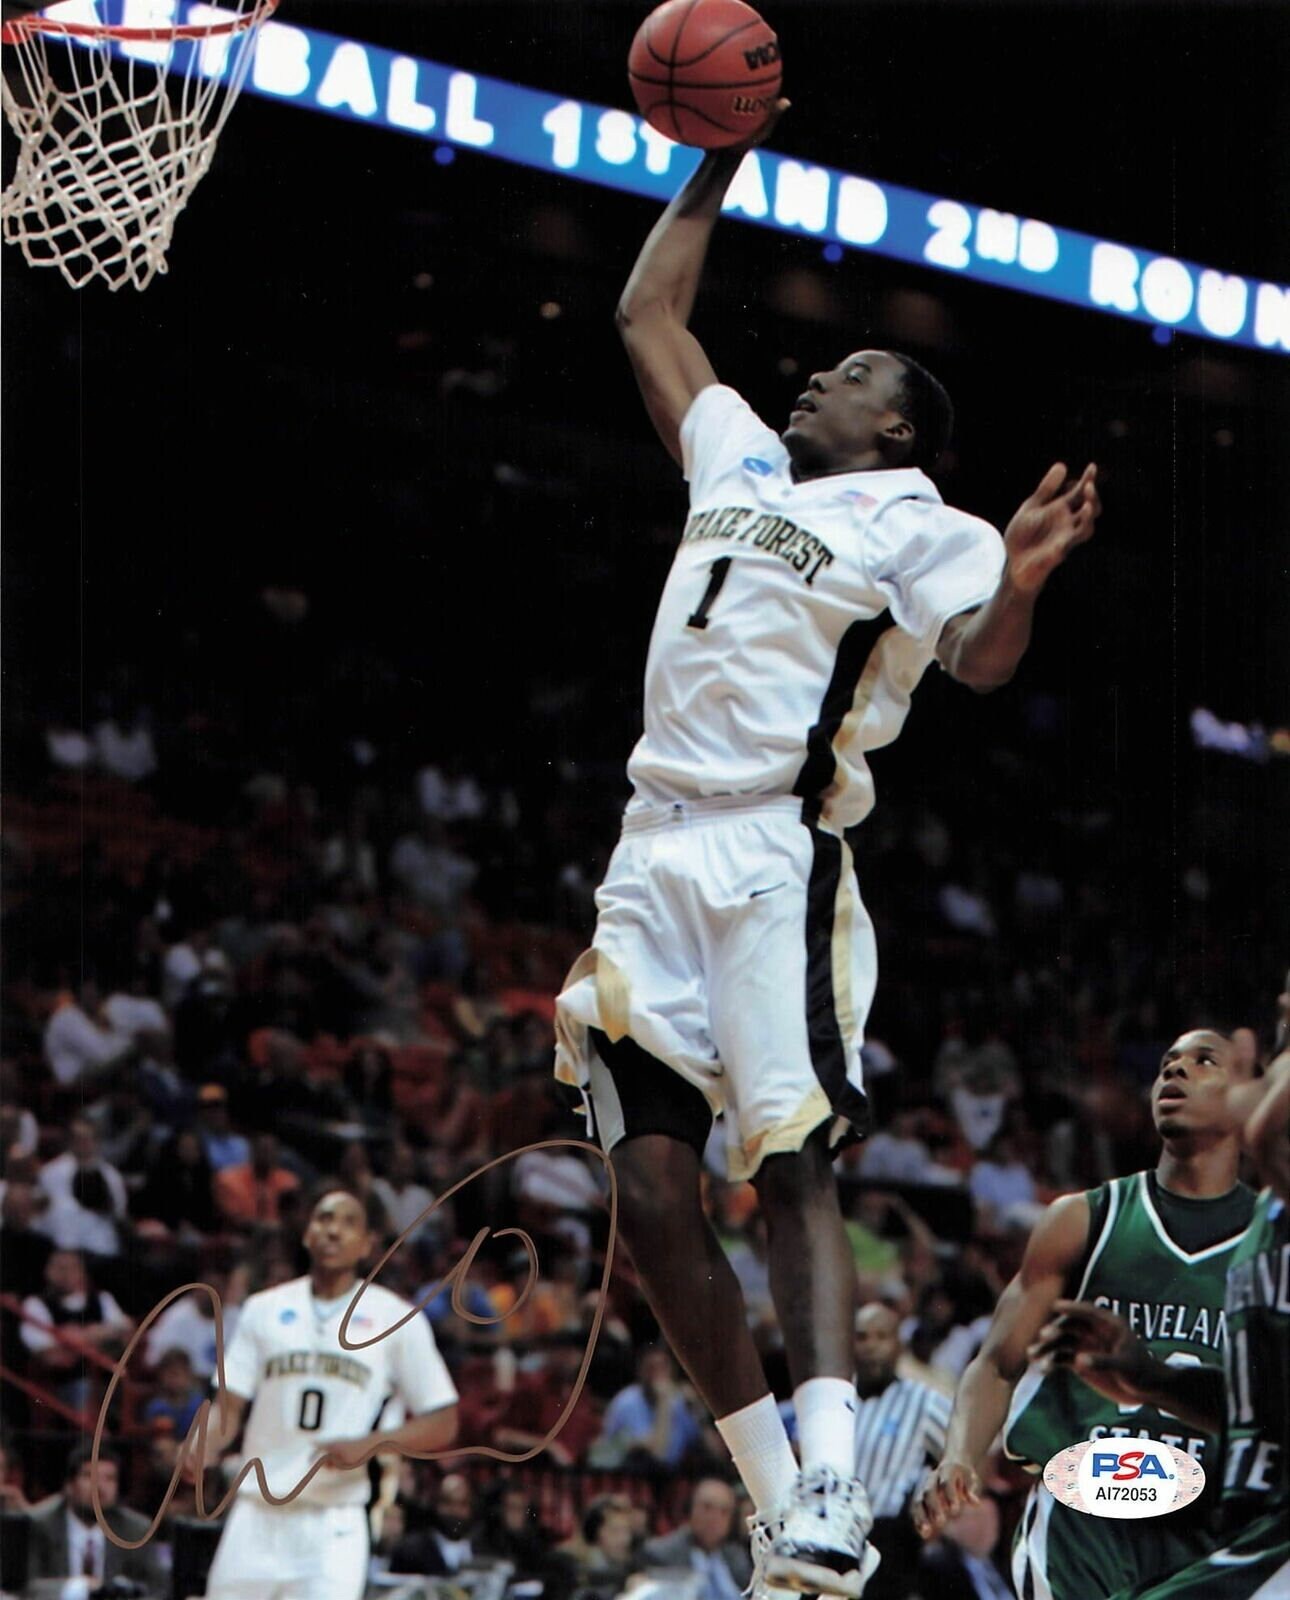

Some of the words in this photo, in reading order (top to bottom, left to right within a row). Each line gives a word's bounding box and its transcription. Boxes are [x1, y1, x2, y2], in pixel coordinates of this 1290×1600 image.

[543, 101, 679, 174] 1ST
[720, 150, 888, 245] AND
[923, 200, 1059, 273] 2ND
[738, 513, 835, 586] FOREST
[686, 556, 732, 629] 1
[298, 1388, 324, 1431] 0
